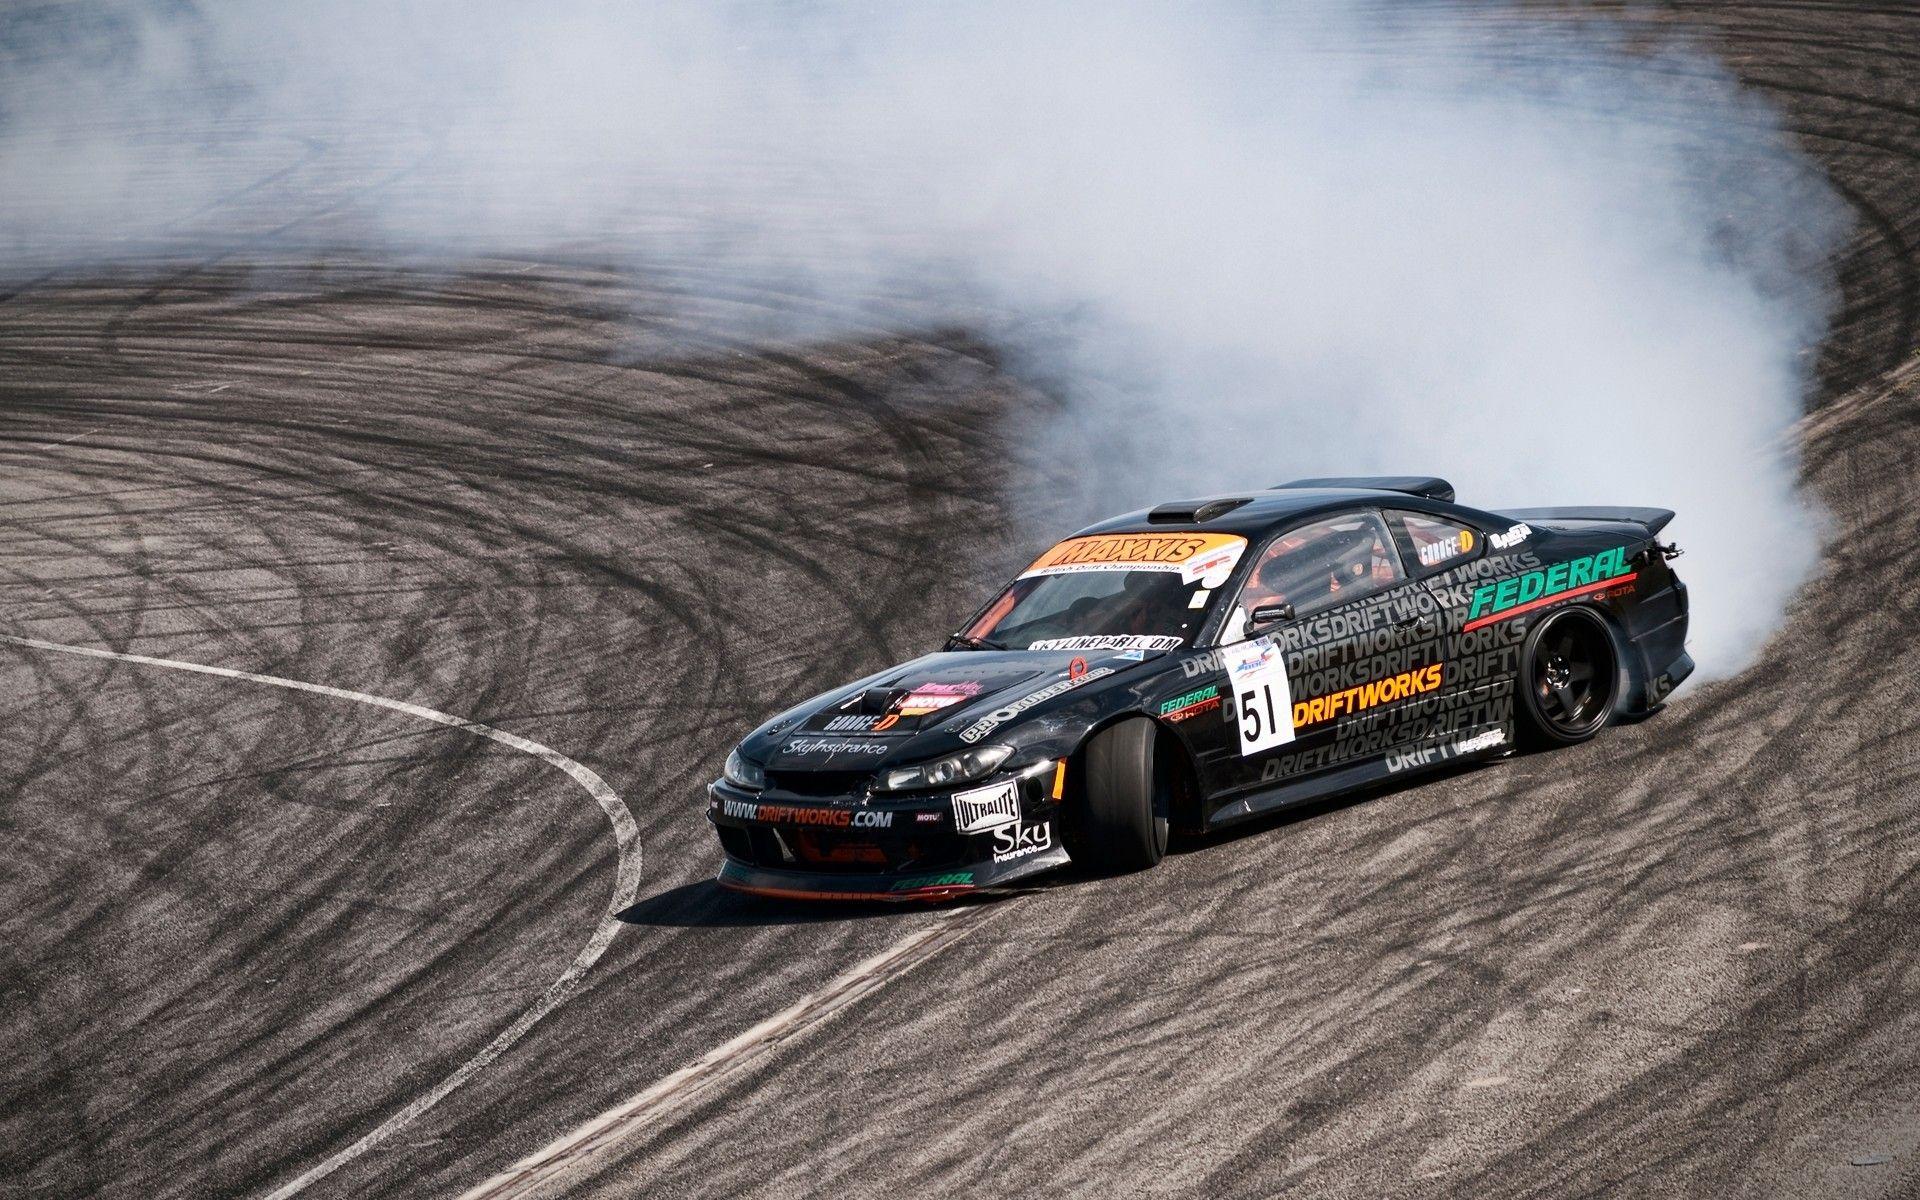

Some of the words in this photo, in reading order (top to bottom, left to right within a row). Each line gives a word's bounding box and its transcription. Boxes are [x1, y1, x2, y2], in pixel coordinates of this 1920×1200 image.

[1049, 538, 1205, 566] MAXXIS
[1103, 563, 1181, 573] Championship
[1467, 546, 1635, 622] FEDERAL
[1160, 685, 1219, 715] FEDERAL
[1294, 664, 1443, 728] DRIFTWORKS
[1241, 685, 1276, 742] 51
[724, 800, 893, 828] WWW.DRIFTWORKS.COM
[958, 787, 1016, 829] ULTRALITE
[993, 821, 1052, 854] Sky
